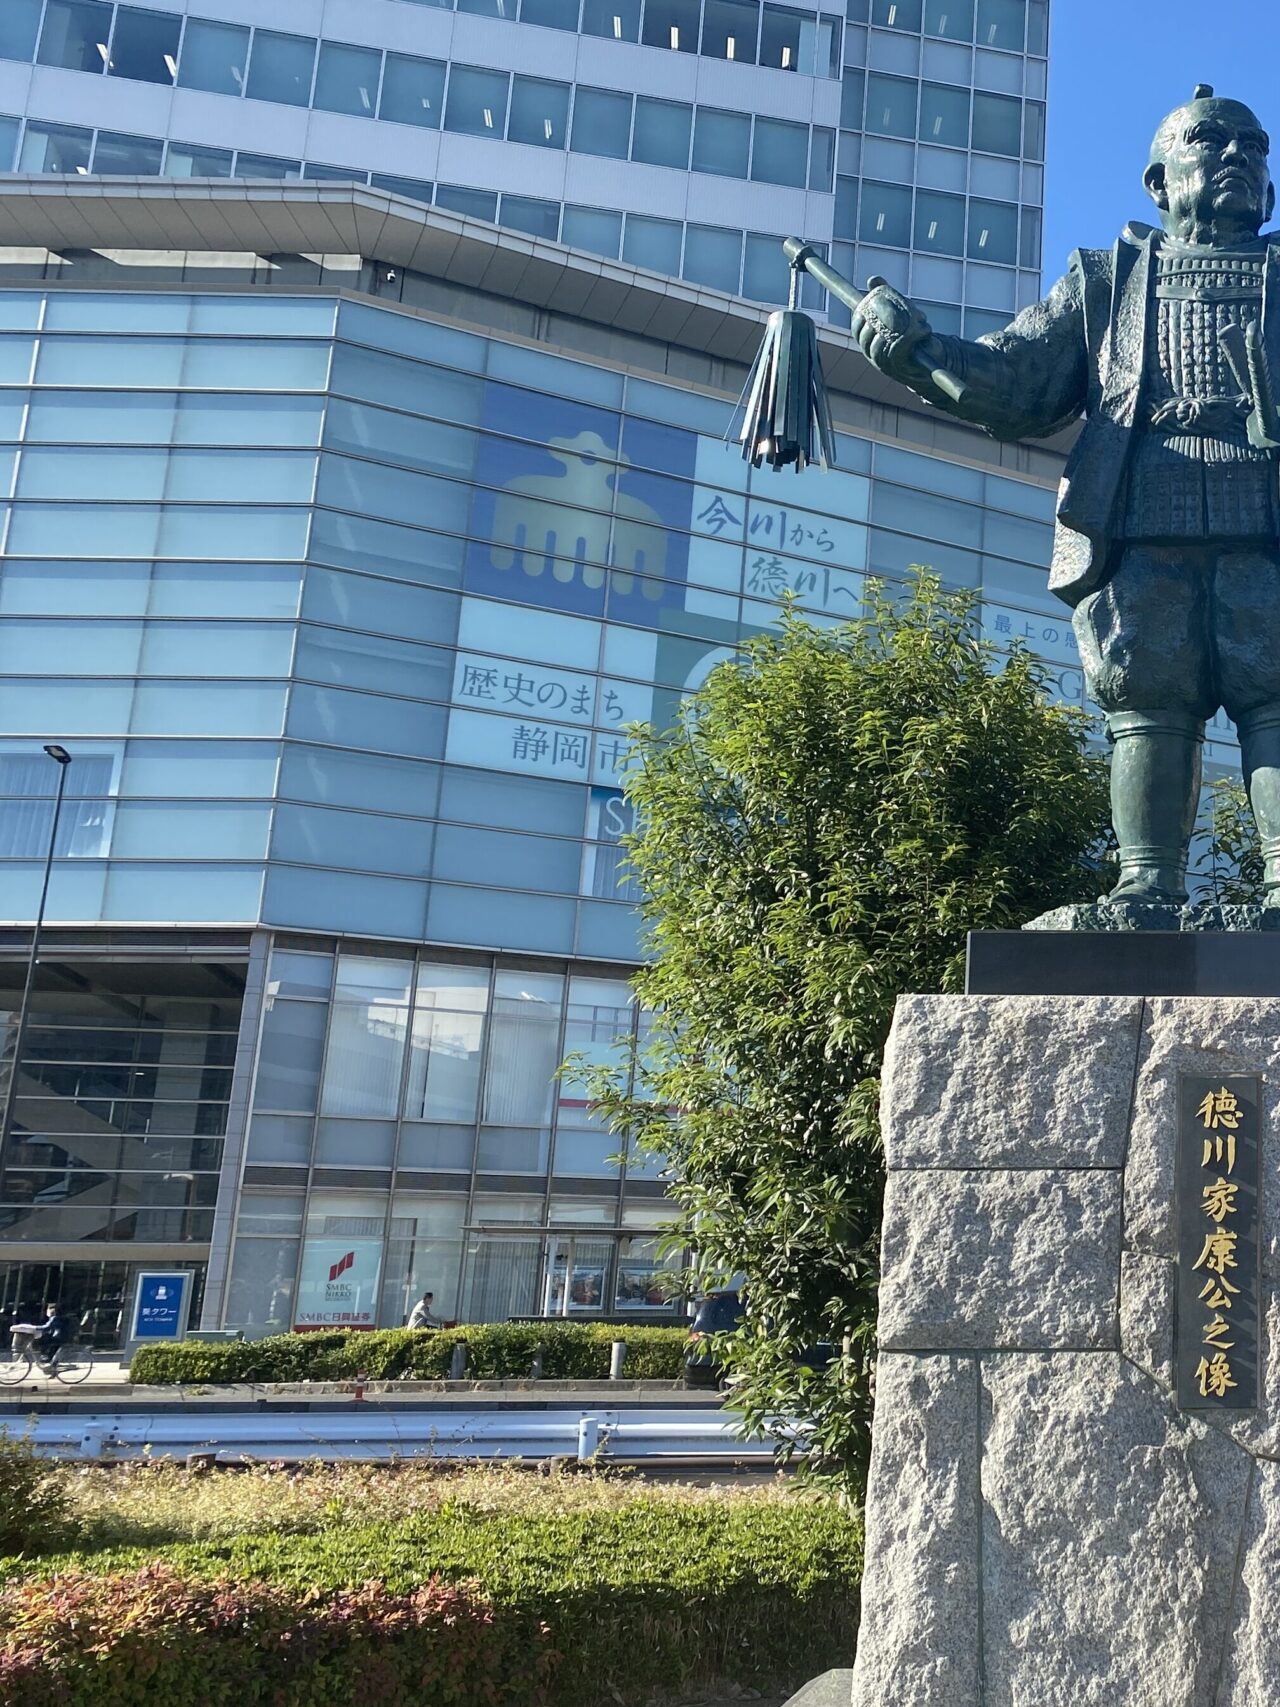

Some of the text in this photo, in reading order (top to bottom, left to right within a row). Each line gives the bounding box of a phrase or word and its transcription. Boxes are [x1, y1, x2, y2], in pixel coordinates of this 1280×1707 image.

[697, 495, 835, 552] 今川から
[458, 664, 624, 721] 歴史のまち
[511, 725, 630, 774] 静岡市
[1191, 1086, 1244, 1397] 徳川家康公之像
